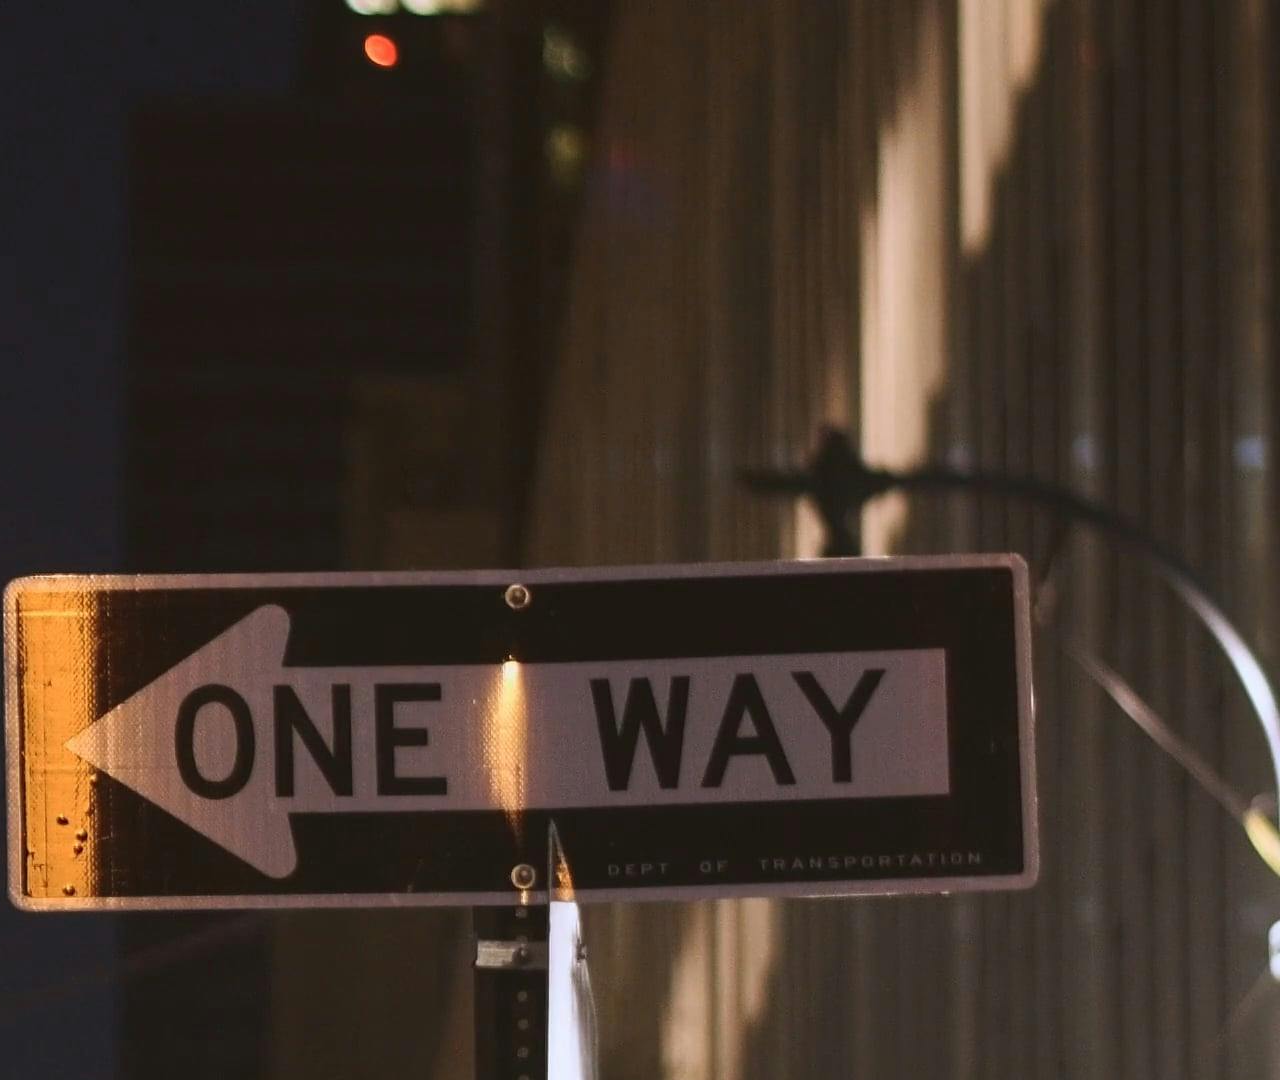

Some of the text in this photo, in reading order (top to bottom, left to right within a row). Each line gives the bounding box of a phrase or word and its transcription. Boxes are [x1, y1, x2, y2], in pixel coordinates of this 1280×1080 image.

[173, 669, 887, 800] ONE WAY
[607, 851, 984, 877] DEPT OF TRANSPORTATION
